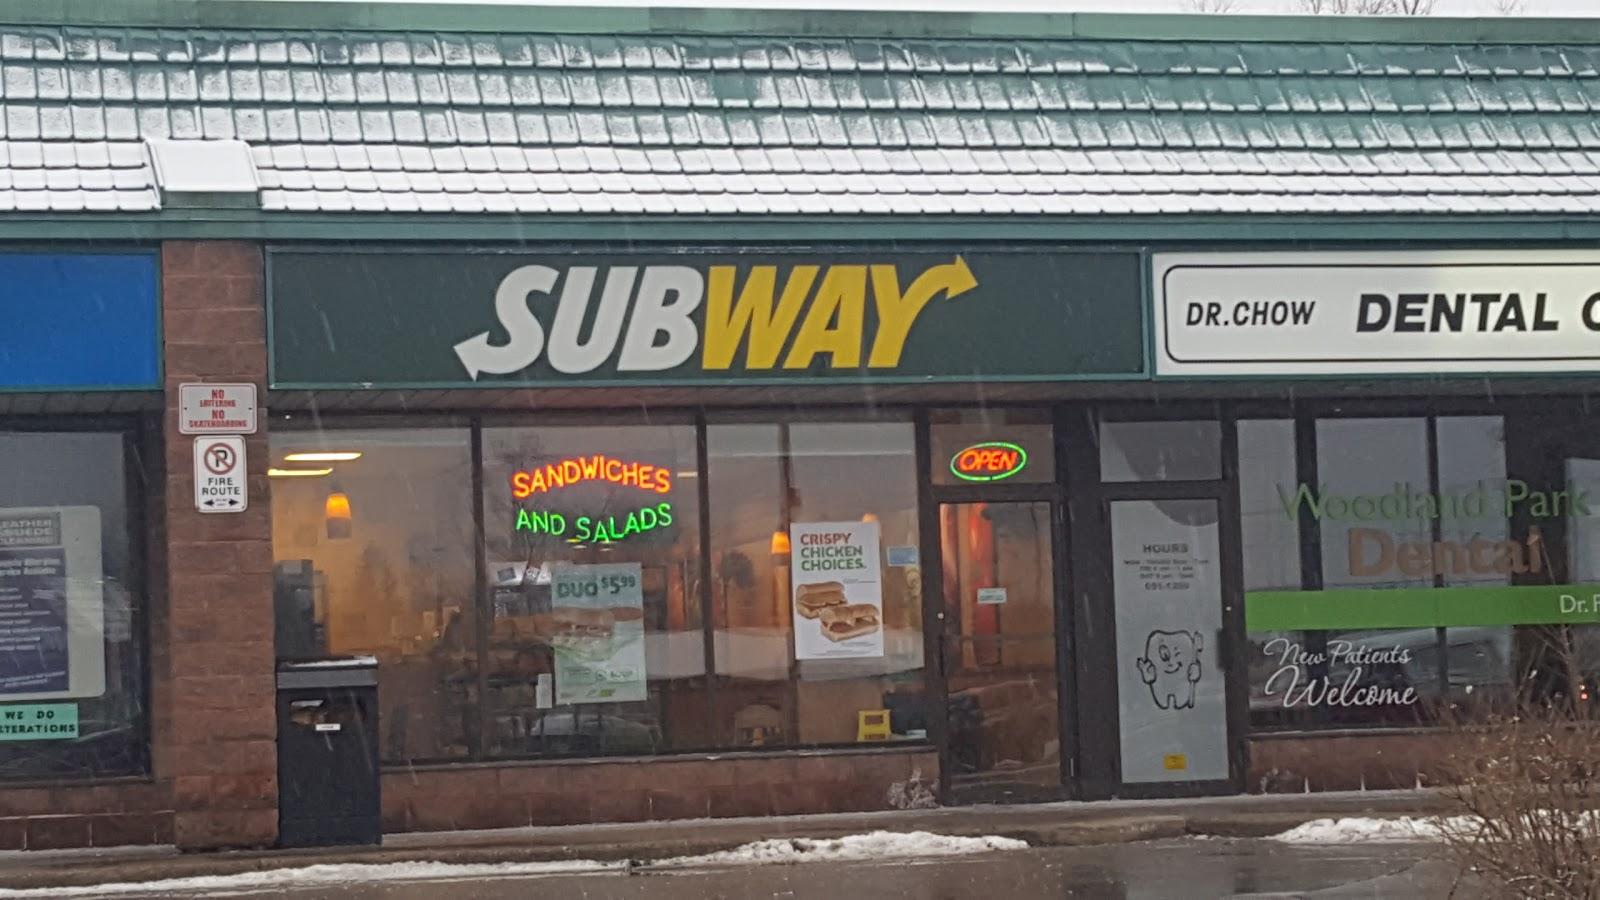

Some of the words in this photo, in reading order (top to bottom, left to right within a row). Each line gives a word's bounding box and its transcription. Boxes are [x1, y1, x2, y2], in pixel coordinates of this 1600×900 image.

[453, 254, 978, 382] SUBWAY
[1185, 301, 1316, 327] DR.CHOW
[1356, 293, 1559, 333] DENTAL
[211, 389, 225, 399] NO
[211, 409, 225, 419] NO
[958, 449, 1018, 472] OPEN
[208, 477, 234, 487] FIRE
[512, 455, 672, 498] SANDWICHES
[201, 486, 241, 496] ROUTE
[1276, 480, 1486, 523] Woodland
[1505, 478, 1592, 518] Park
[515, 508, 566, 536] AND
[575, 502, 673, 544] SALADS
[800, 533, 852, 546] CRISPY
[801, 546, 863, 558] CHICKEN
[1142, 543, 1189, 554] HOURS
[1348, 525, 1543, 578] Dental
[801, 558, 867, 572] CHOICES.
[557, 582, 598, 598] DUO
[1560, 594, 1589, 613] Dr.
[1263, 638, 1326, 666] New
[1327, 640, 1412, 667] Patients
[1264, 664, 1418, 707] Welcome
[5, 711, 24, 720] WE
[36, 710, 55, 720] DO
